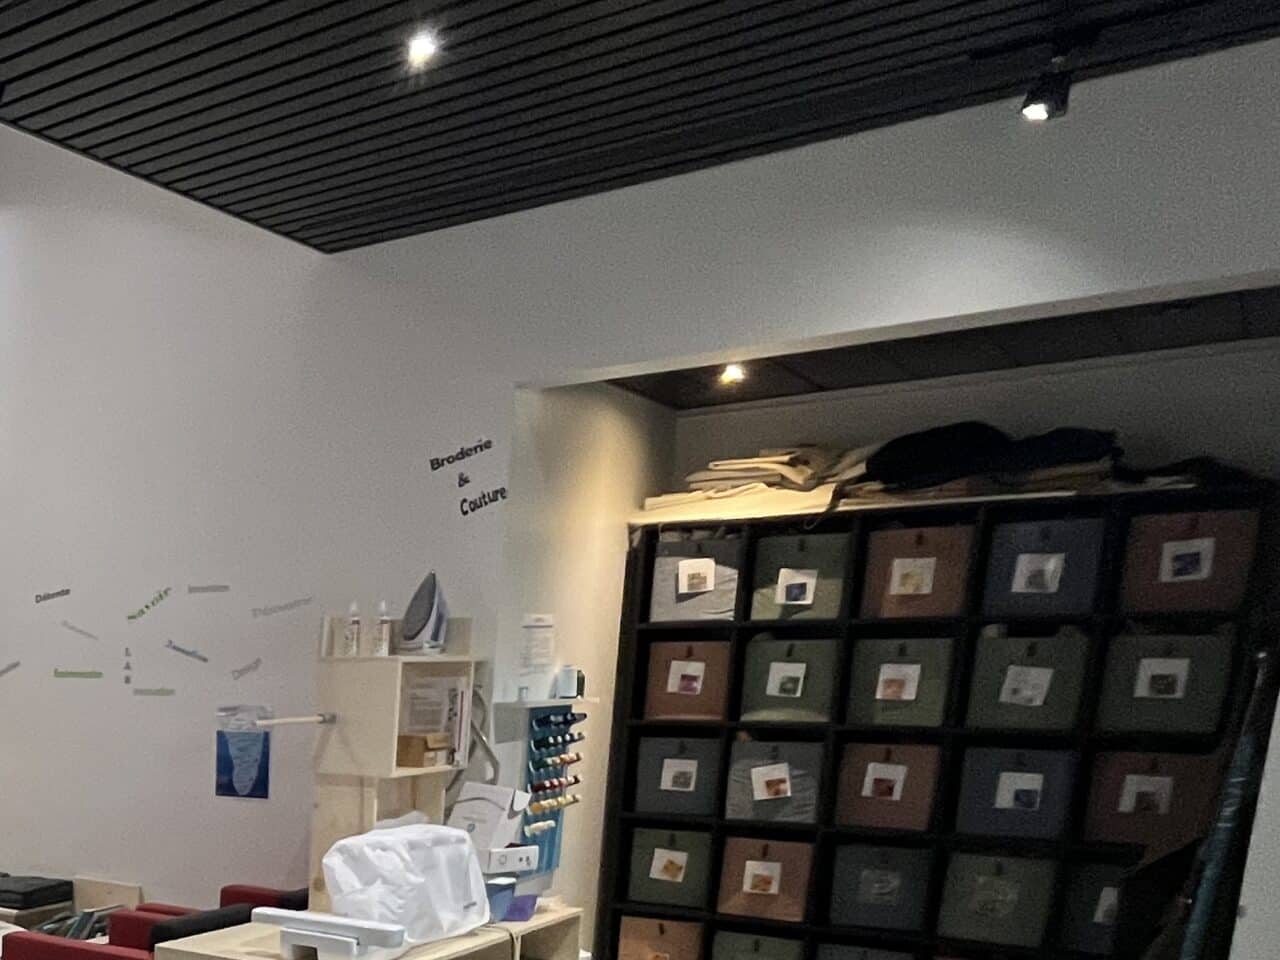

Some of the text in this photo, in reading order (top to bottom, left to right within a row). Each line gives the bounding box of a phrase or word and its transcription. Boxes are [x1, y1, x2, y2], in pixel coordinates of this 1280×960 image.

[429, 438, 493, 471] Broderie
[458, 472, 470, 488] &
[460, 487, 507, 516] Couture
